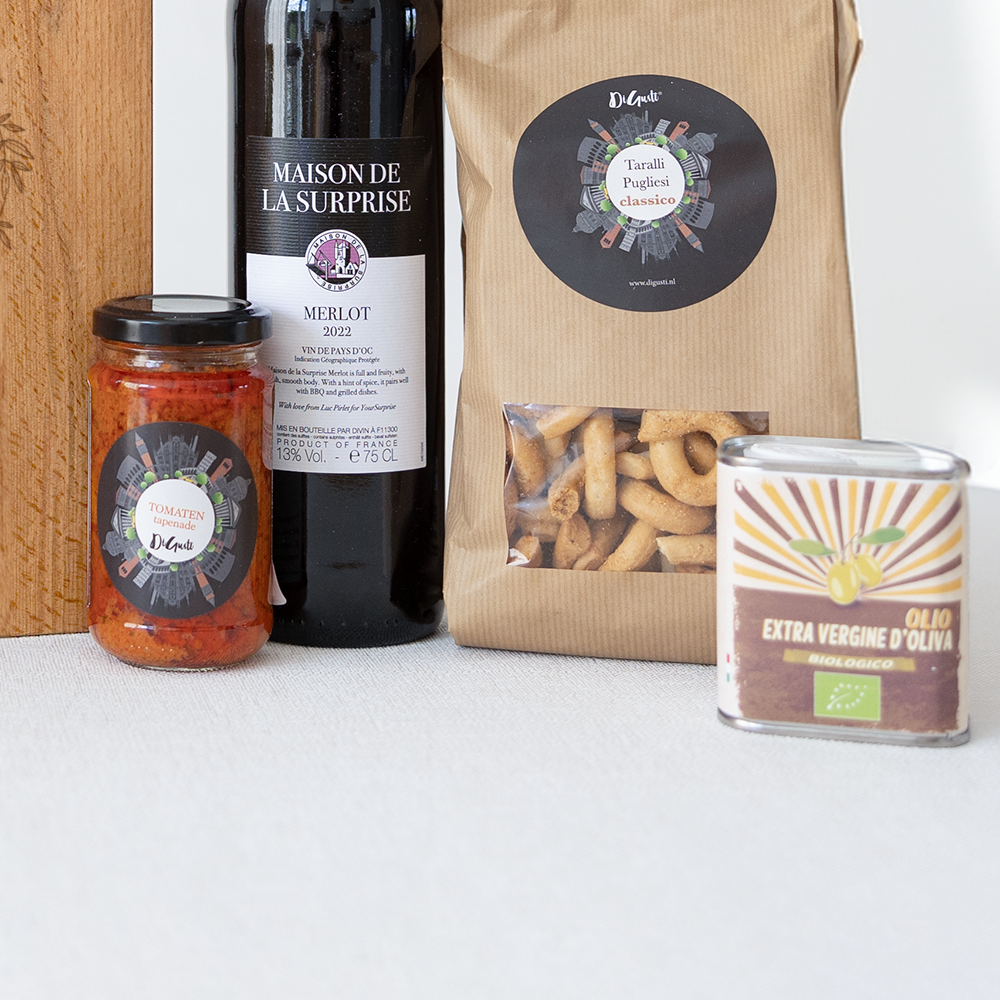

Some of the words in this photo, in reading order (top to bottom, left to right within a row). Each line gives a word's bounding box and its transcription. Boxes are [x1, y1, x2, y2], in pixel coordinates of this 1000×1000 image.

[624, 158, 665, 170] Taralli
[273, 162, 364, 184] MAISON
[369, 162, 401, 184] DE
[622, 176, 670, 190] Pugliesi
[262, 189, 292, 212] LA
[296, 189, 412, 213] SURPRISE
[619, 194, 676, 207] classico
[314, 233, 347, 248] MAISON
[628, 278, 676, 287] www.digusti.nl
[303, 306, 372, 321] MERLOT
[323, 326, 352, 337] 2022
[331, 347, 351, 355] PAYS
[352, 346, 373, 355] D'OC
[302, 369, 327, 377] Surprise
[310, 388, 324, 396] BBQ
[338, 389, 357, 397] grilled
[304, 403, 319, 412] from
[348, 404, 360, 413] for
[277, 438, 328, 448] PRODUCT
[356, 440, 398, 448] FRANCE
[277, 447, 302, 462] 13%
[305, 449, 326, 463] Vol.
[363, 449, 379, 463] 75
[382, 448, 398, 462] CL
[148, 502, 205, 520] TOMATEN
[153, 515, 196, 531] tapenade
[904, 606, 952, 630] OLIO
[762, 618, 814, 644] EXTRA
[817, 622, 887, 649] VERGINE
[890, 628, 952, 652] D'OLIVA
[808, 654, 894, 670] BIOLOGICO
